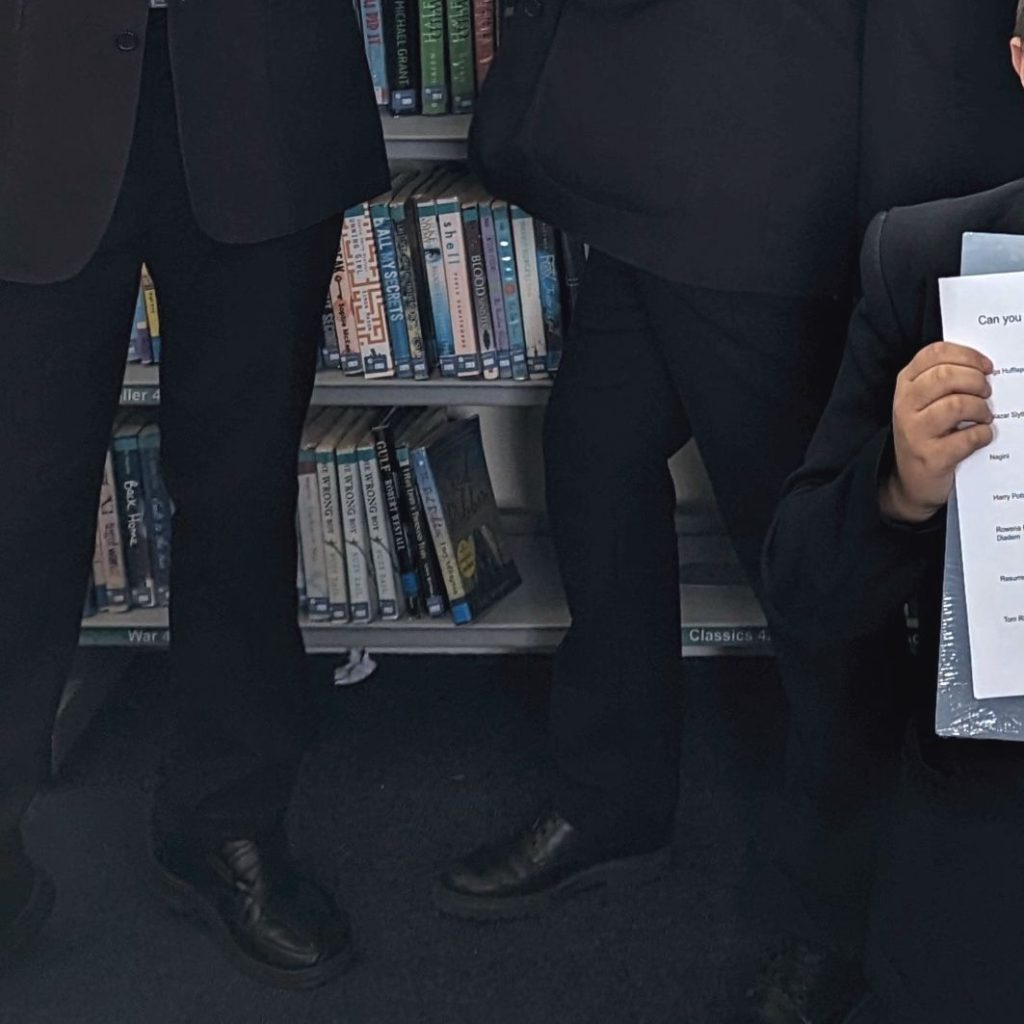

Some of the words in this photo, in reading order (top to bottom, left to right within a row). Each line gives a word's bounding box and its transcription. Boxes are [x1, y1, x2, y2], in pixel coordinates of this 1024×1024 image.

[366, 12, 378, 31] DID
[395, 0, 407, 47] MICHAEL
[368, 34, 380, 46] IT
[397, 48, 409, 86] GRANT
[377, 229, 390, 250] ALL
[443, 221, 460, 265] shell
[351, 254, 362, 275] GIRL
[380, 253, 395, 271] MY
[471, 255, 485, 296] BLOOD
[361, 290, 369, 310] SIMON
[384, 271, 403, 322] SECRETS
[337, 303, 347, 327] Sophie
[363, 312, 372, 332] MASON
[978, 314, 1000, 326] Can
[1003, 312, 1022, 325] you
[989, 452, 1010, 461] Nagini
[123, 480, 137, 510] Back
[321, 476, 333, 517] WRONG
[344, 475, 356, 516] WRONG
[364, 473, 378, 514] WRONG
[371, 515, 380, 532] BOY
[376, 441, 390, 473] GULF
[384, 479, 398, 511] ROBERT
[391, 514, 405, 551] WESTALL
[993, 493, 1012, 503] Harry
[128, 513, 143, 546] Home
[326, 518, 335, 534] BOY
[349, 518, 358, 534] BOY
[996, 525, 1022, 533] Rowena
[996, 533, 1021, 542] Diadem
[128, 630, 157, 642] War
[689, 629, 752, 641] Classics
